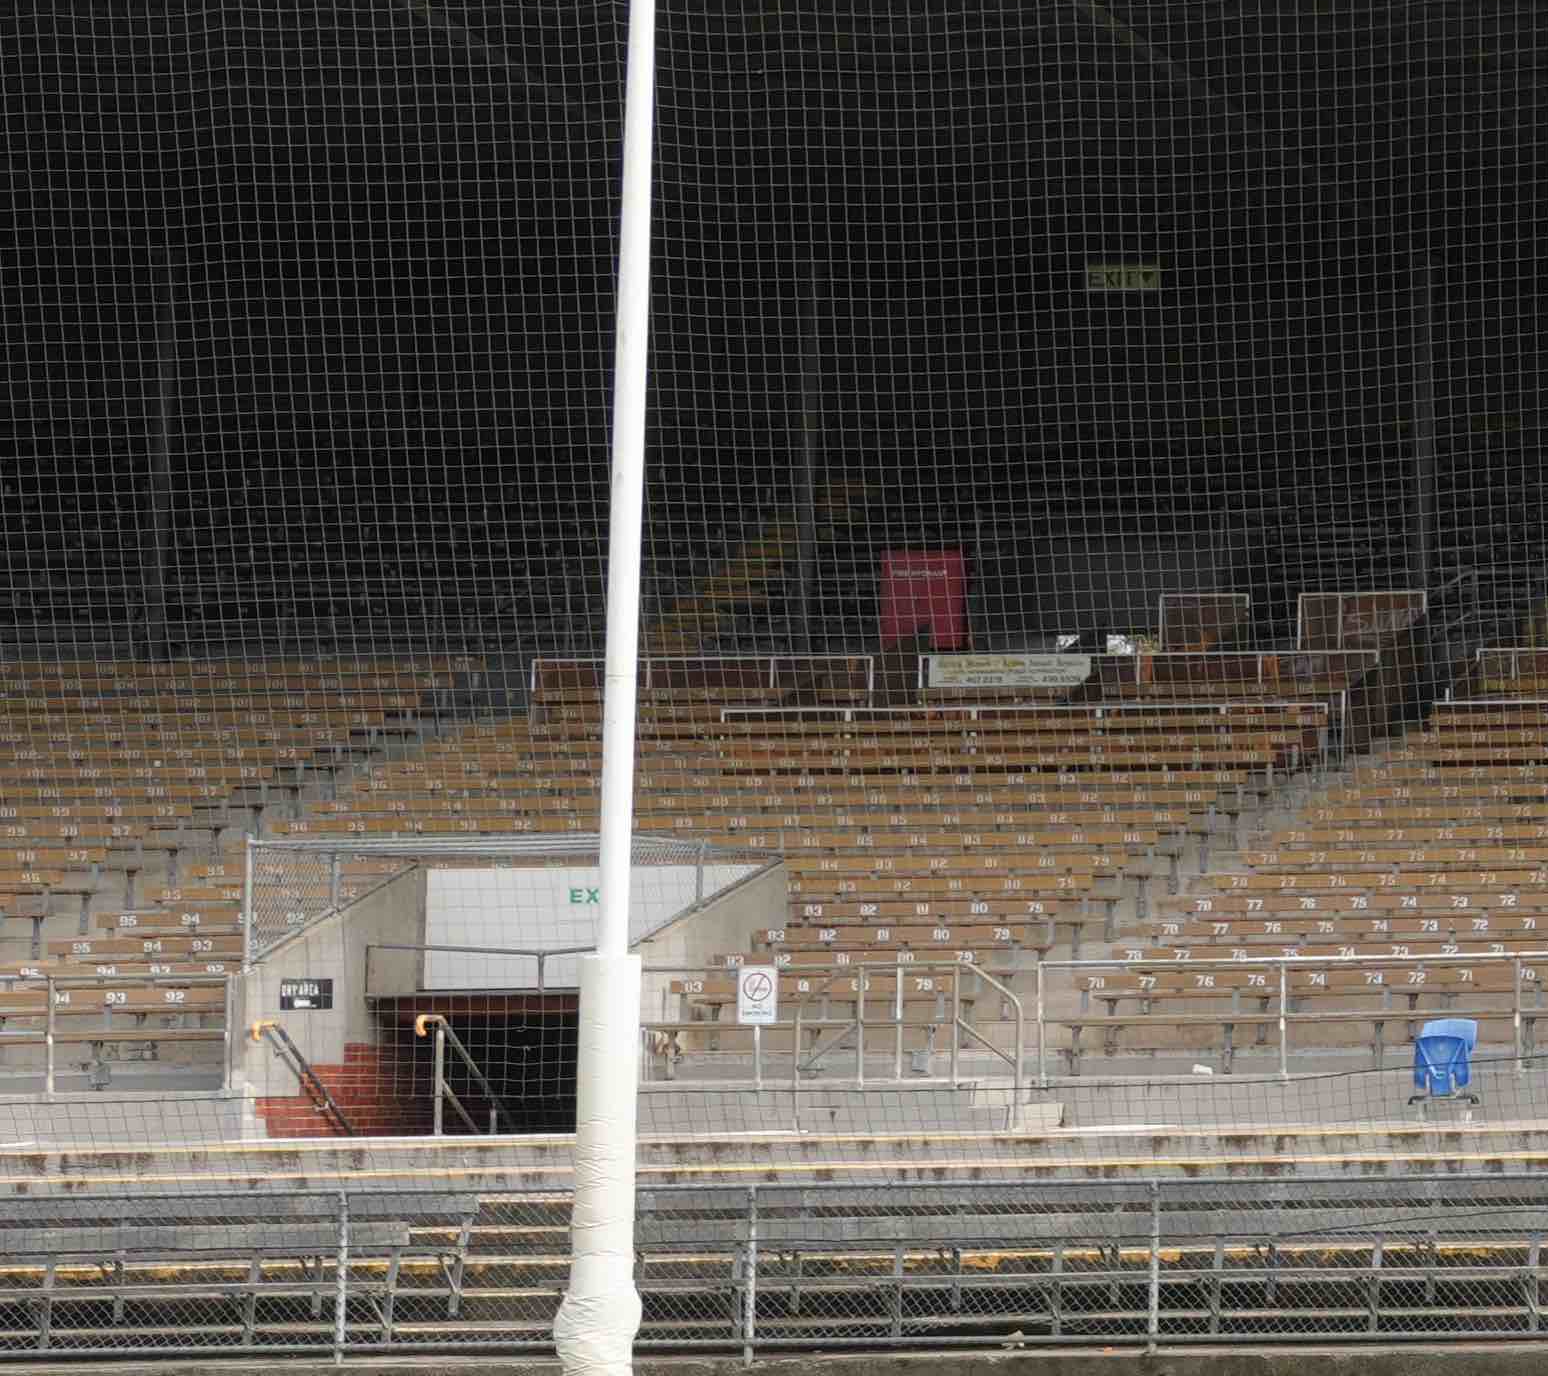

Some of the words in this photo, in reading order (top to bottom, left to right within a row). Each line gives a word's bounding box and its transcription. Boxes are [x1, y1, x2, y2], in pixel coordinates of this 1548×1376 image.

[569, 887, 600, 904] EX
[1246, 899, 1263, 911] 77
[1299, 897, 1316, 909] 76
[1350, 896, 1368, 909] 75
[1400, 896, 1417, 908] 74
[1451, 895, 1468, 908] 73
[1499, 894, 1516, 906] 72
[119, 915, 137, 927] 95
[181, 913, 201, 925] 94
[993, 927, 1010, 941] 79
[72, 942, 91, 954] 95
[143, 940, 162, 953] 94
[191, 939, 213, 951] 93
[915, 978, 933, 991] 79
[1138, 976, 1157, 988] 77
[1196, 975, 1215, 988] 76
[1247, 974, 1266, 986] 75
[1308, 973, 1325, 985] 74
[1364, 971, 1383, 985] 73
[1408, 971, 1426, 984] 72
[1458, 969, 1473, 982] 71
[106, 992, 126, 1004] 93
[165, 991, 185, 1003] 92
